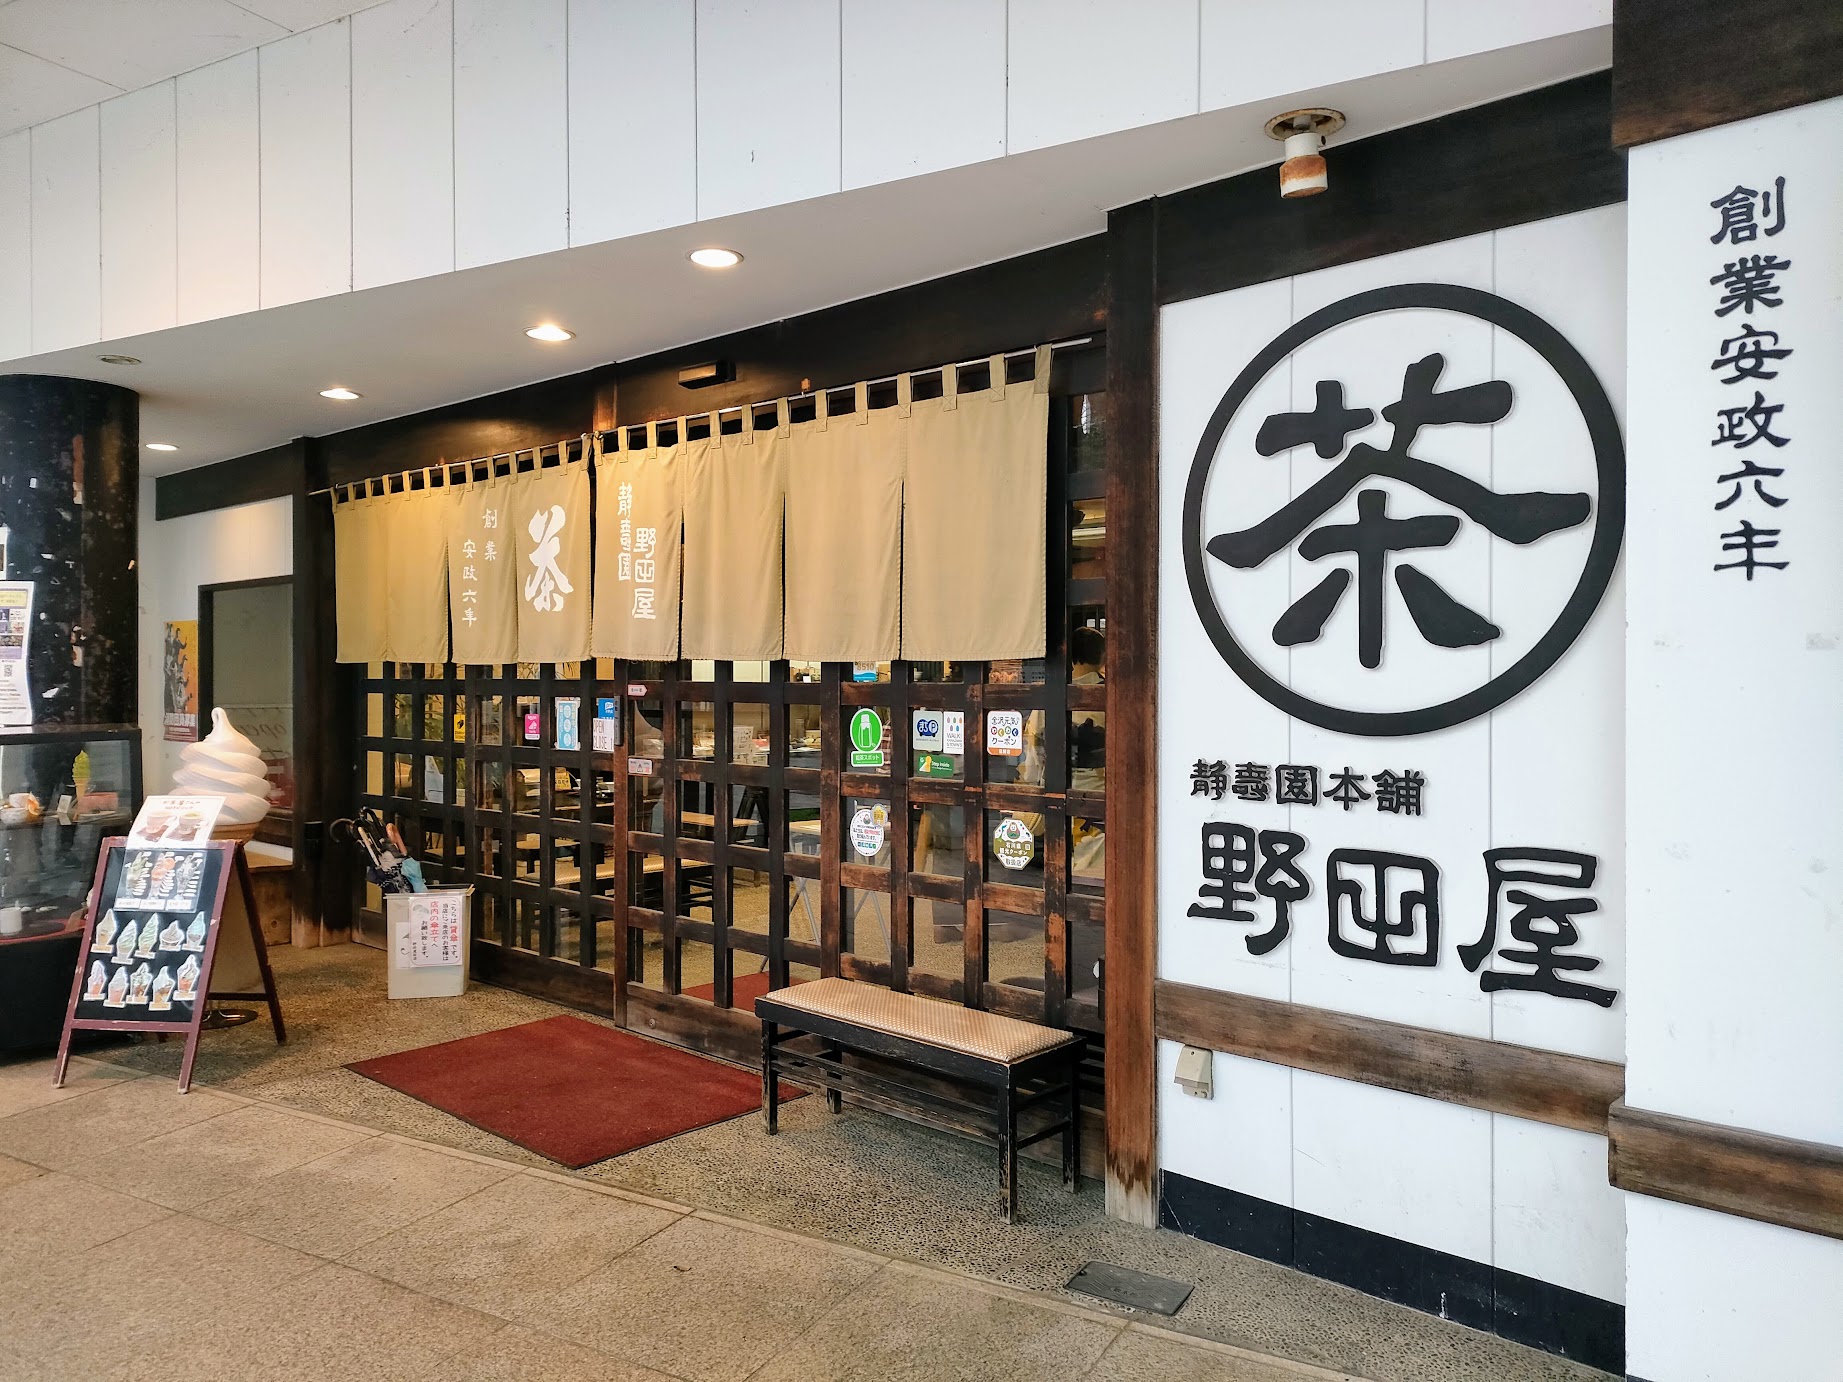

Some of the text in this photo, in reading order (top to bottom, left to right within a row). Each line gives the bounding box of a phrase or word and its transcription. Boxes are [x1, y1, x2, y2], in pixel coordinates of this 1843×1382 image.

[1710, 175, 1794, 581] 創業安政六年
[482, 508, 498, 562] 創業
[524, 504, 575, 613] 茶
[1206, 352, 1591, 669] 茶
[462, 539, 478, 628] 安政六年
[632, 527, 657, 620] 野田屋
[1187, 822, 1618, 1008] 野田屋
